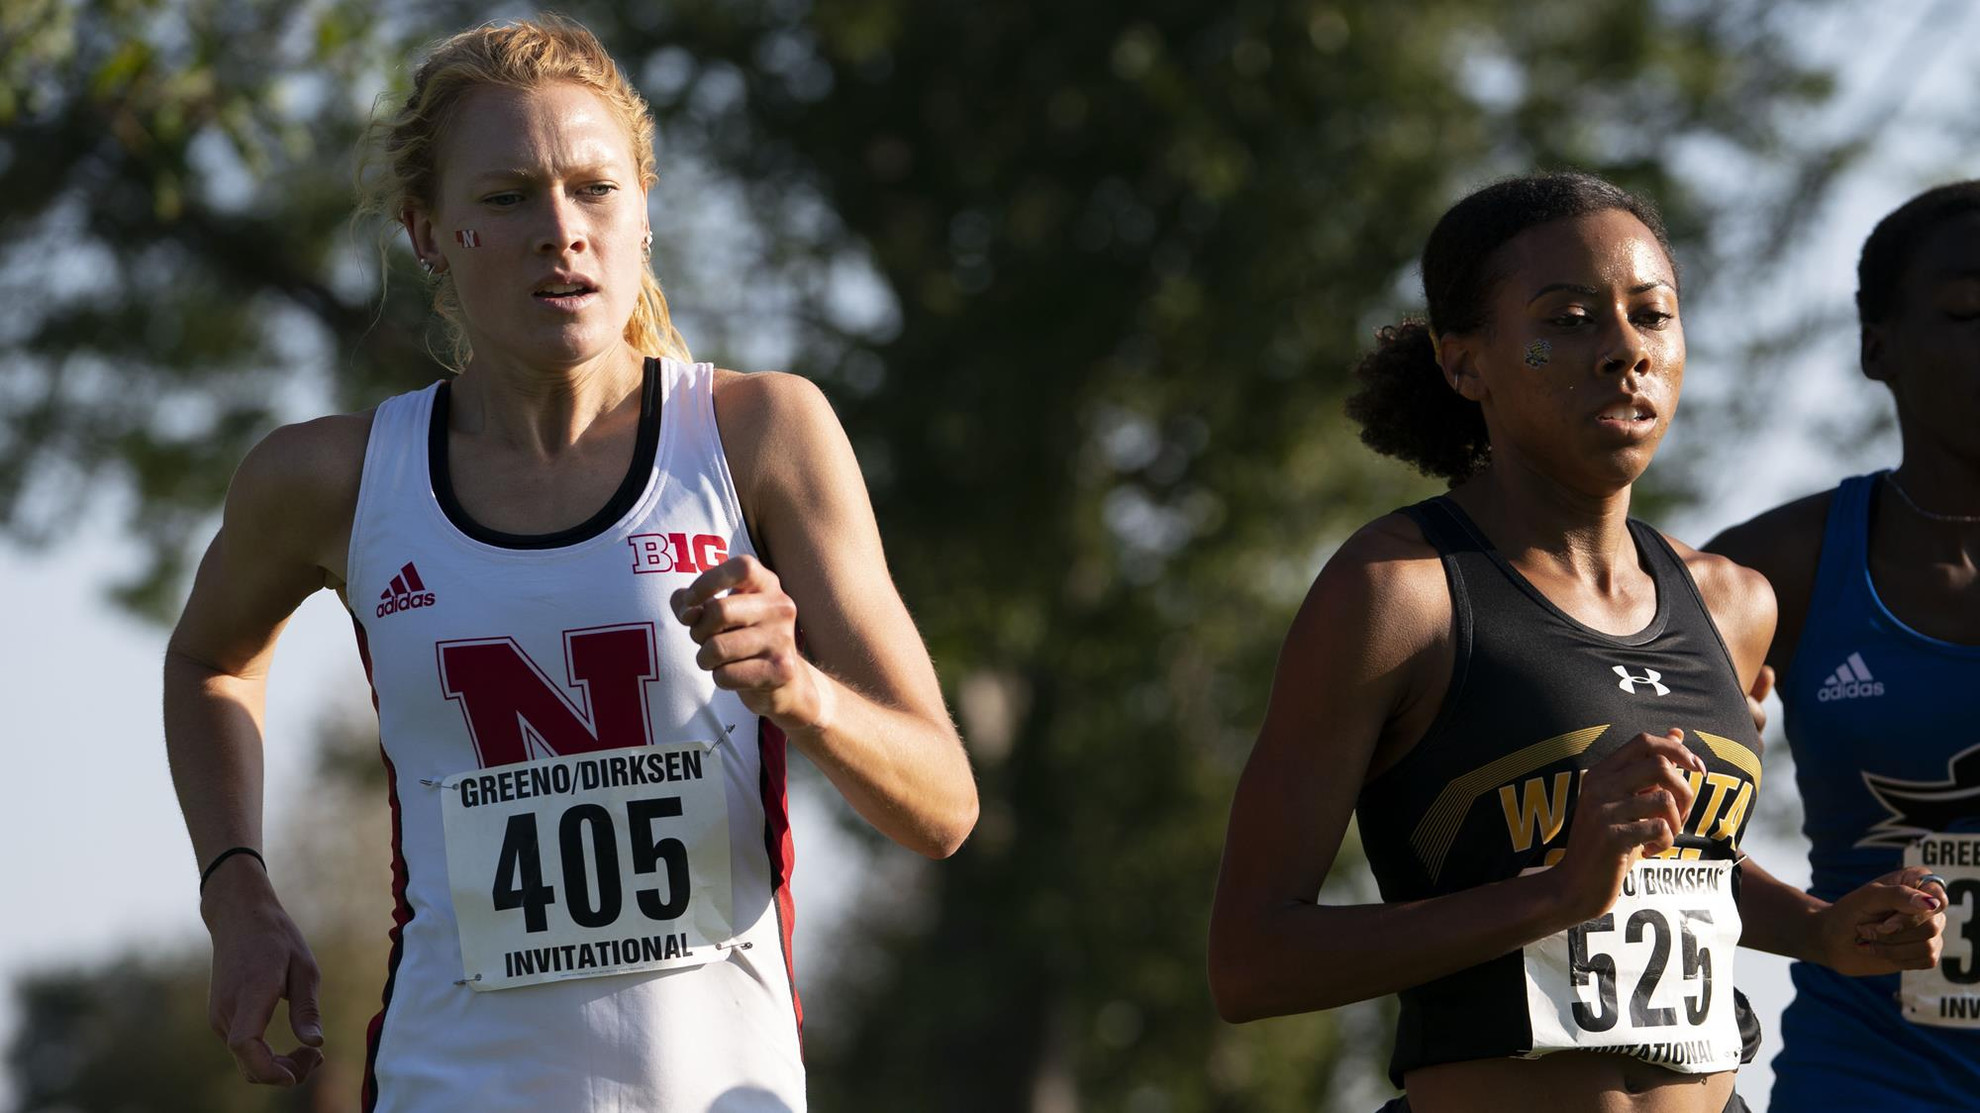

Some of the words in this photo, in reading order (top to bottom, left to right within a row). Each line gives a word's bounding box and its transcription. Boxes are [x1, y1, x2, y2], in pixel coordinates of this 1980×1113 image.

[376, 592, 436, 618] adidas
[436, 622, 659, 769] N
[1817, 681, 1885, 702] adidas
[460, 750, 704, 808] GREENO/DIRKSEN
[1498, 768, 1754, 853] WITA
[492, 796, 691, 933] 405
[505, 933, 693, 978] INVITATIONAL
[1567, 908, 1714, 1033] 525
